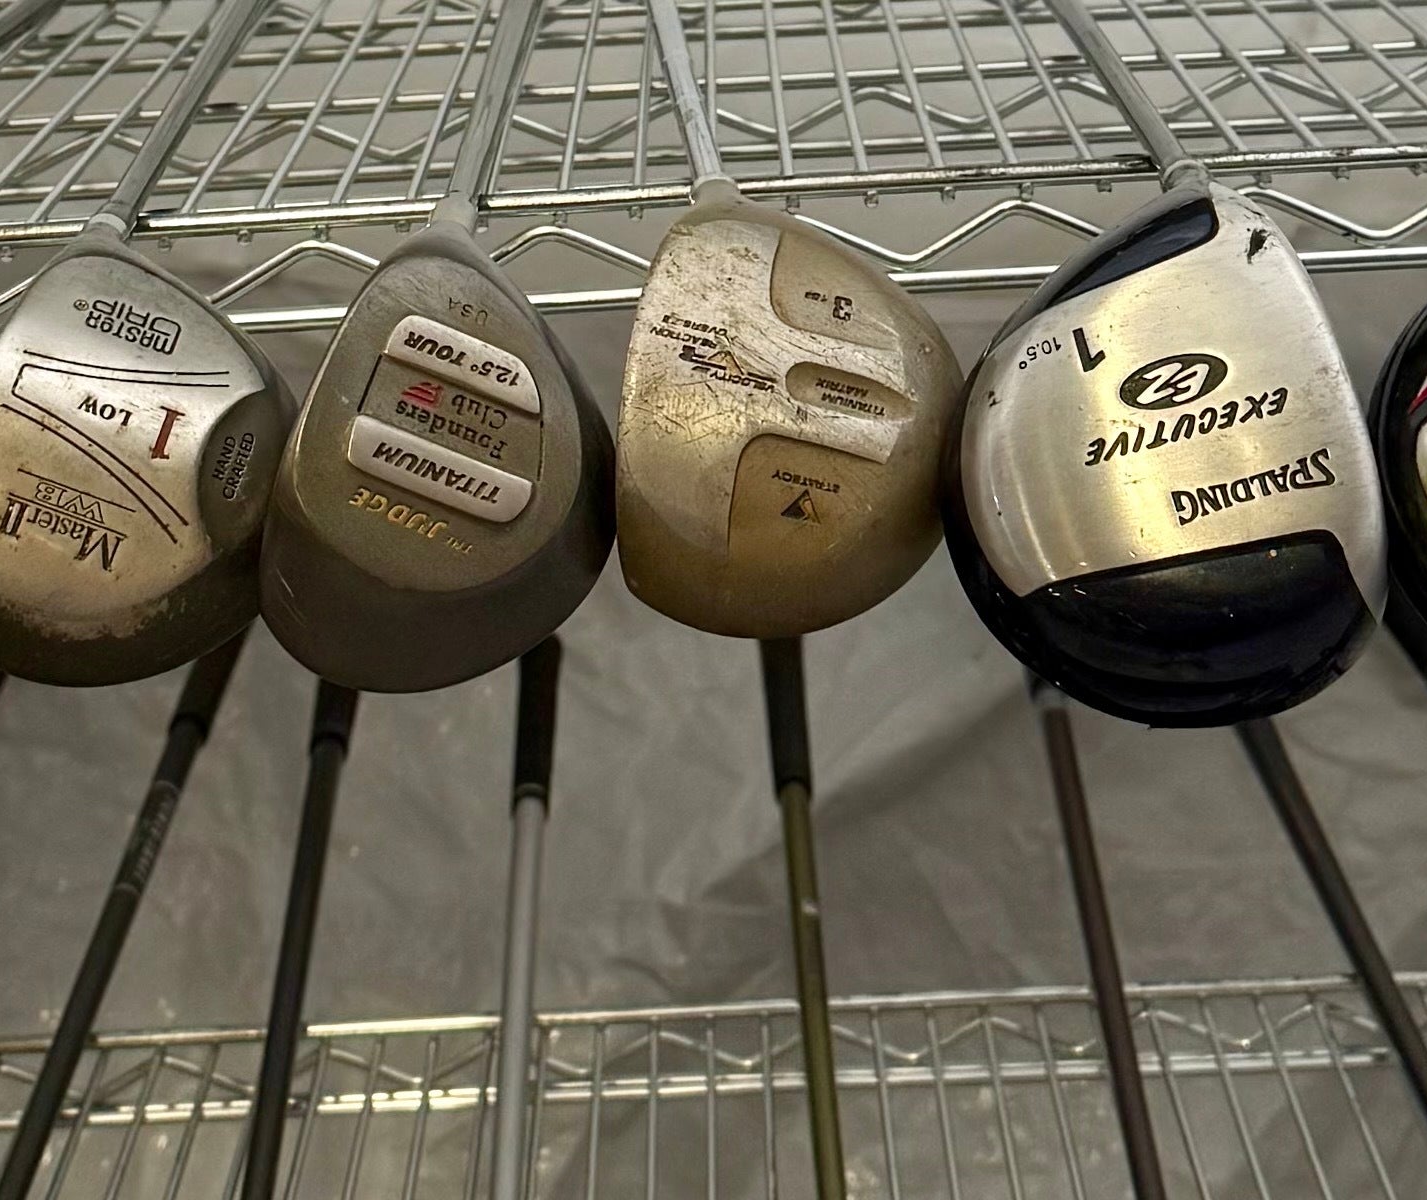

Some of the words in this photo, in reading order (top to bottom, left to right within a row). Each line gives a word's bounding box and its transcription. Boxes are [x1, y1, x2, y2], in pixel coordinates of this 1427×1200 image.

[448, 296, 489, 326] USA
[832, 295, 853, 322] 3
[86, 311, 174, 355] MASTER
[404, 330, 464, 370] TOUR
[649, 324, 717, 350] REACTION
[1072, 327, 1106, 374] 1
[469, 355, 521, 388] 12.5°
[1018, 336, 1062, 371] 10.5°
[814, 376, 870, 397] MATRIX
[821, 393, 886, 417] TITANIUM
[77, 395, 134, 427] LOW
[395, 399, 509, 461] Founders
[451, 393, 508, 429] Club
[1084, 386, 1289, 468] EXECUTIVE
[212, 435, 236, 482] HAND
[222, 432, 255, 501] CRAFTED
[372, 440, 501, 505] TITANIUM
[1171, 447, 1336, 527] SPALDING
[348, 485, 449, 540] JUDGE
